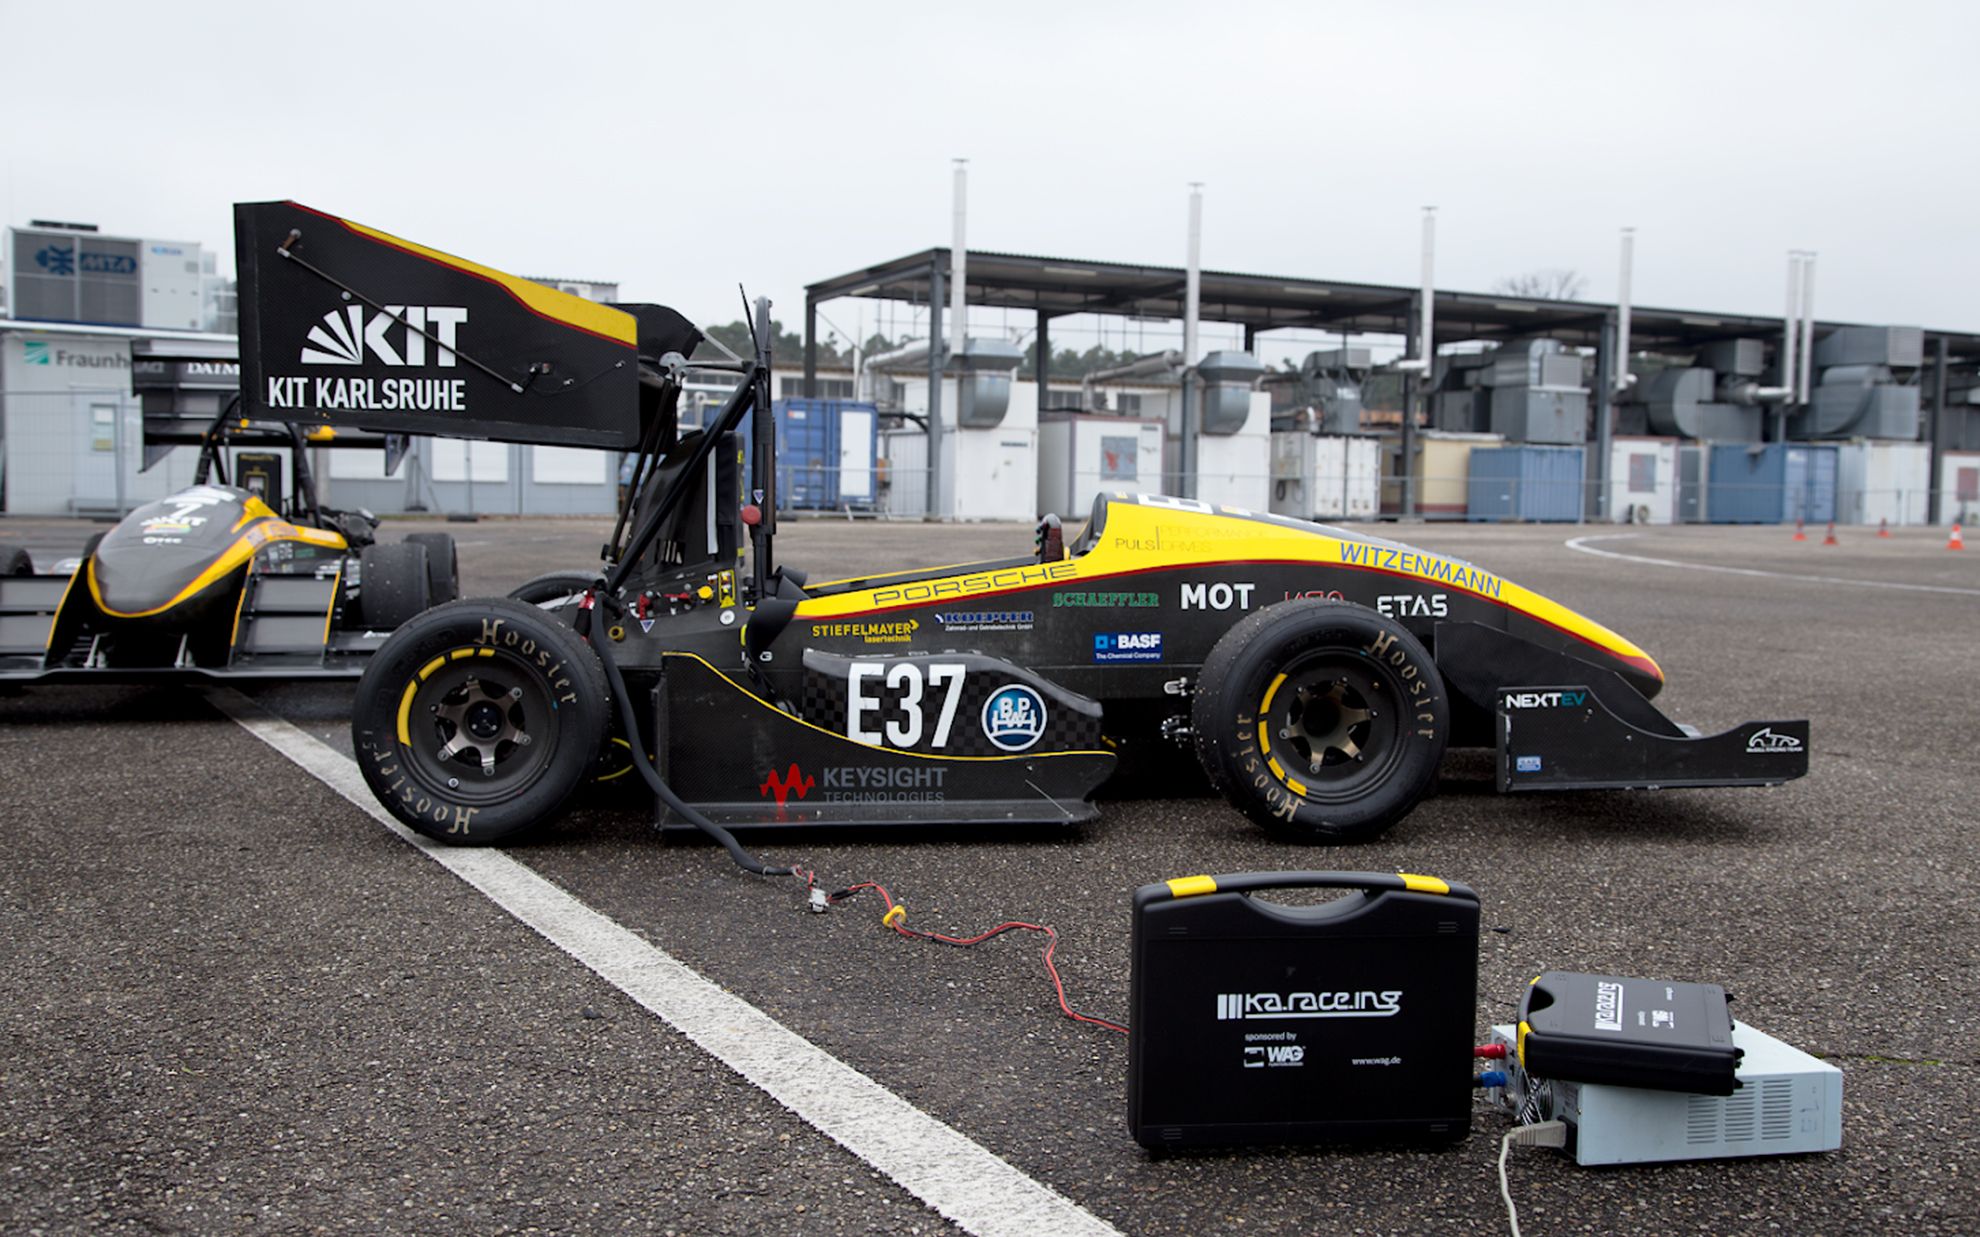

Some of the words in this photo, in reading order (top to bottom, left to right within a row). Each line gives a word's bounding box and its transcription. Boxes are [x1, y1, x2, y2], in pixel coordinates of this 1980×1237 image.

[364, 304, 468, 367] KIT
[268, 377, 309, 408] KIT
[316, 377, 467, 411] KARLSRUHE
[1115, 538, 1156, 551] PULS
[1340, 541, 1502, 598] WITZENMANN
[873, 563, 1079, 606] PORSCHE
[1180, 583, 1256, 610] MOT
[1052, 592, 1160, 608] SCHAEFFLER
[1377, 594, 1448, 618] ETAS
[812, 621, 912, 638] STIEFELMAYER
[944, 611, 1035, 624] KOEPFER
[864, 633, 912, 644] lasertechnik
[1117, 633, 1161, 649] BASF
[474, 618, 577, 705] Hoosier
[1363, 630, 1440, 740] Hoosier
[847, 662, 967, 748] E37
[1505, 692, 1586, 709] NEXTEV
[823, 766, 948, 788] KEYSIGHT
[1231, 713, 1307, 823] Hoosier
[373, 749, 481, 836] Hoosier
[823, 791, 945, 803] TECHNOLOGIES
[1244, 1032, 1285, 1042] sponsored
[1286, 1032, 1297, 1042] by
